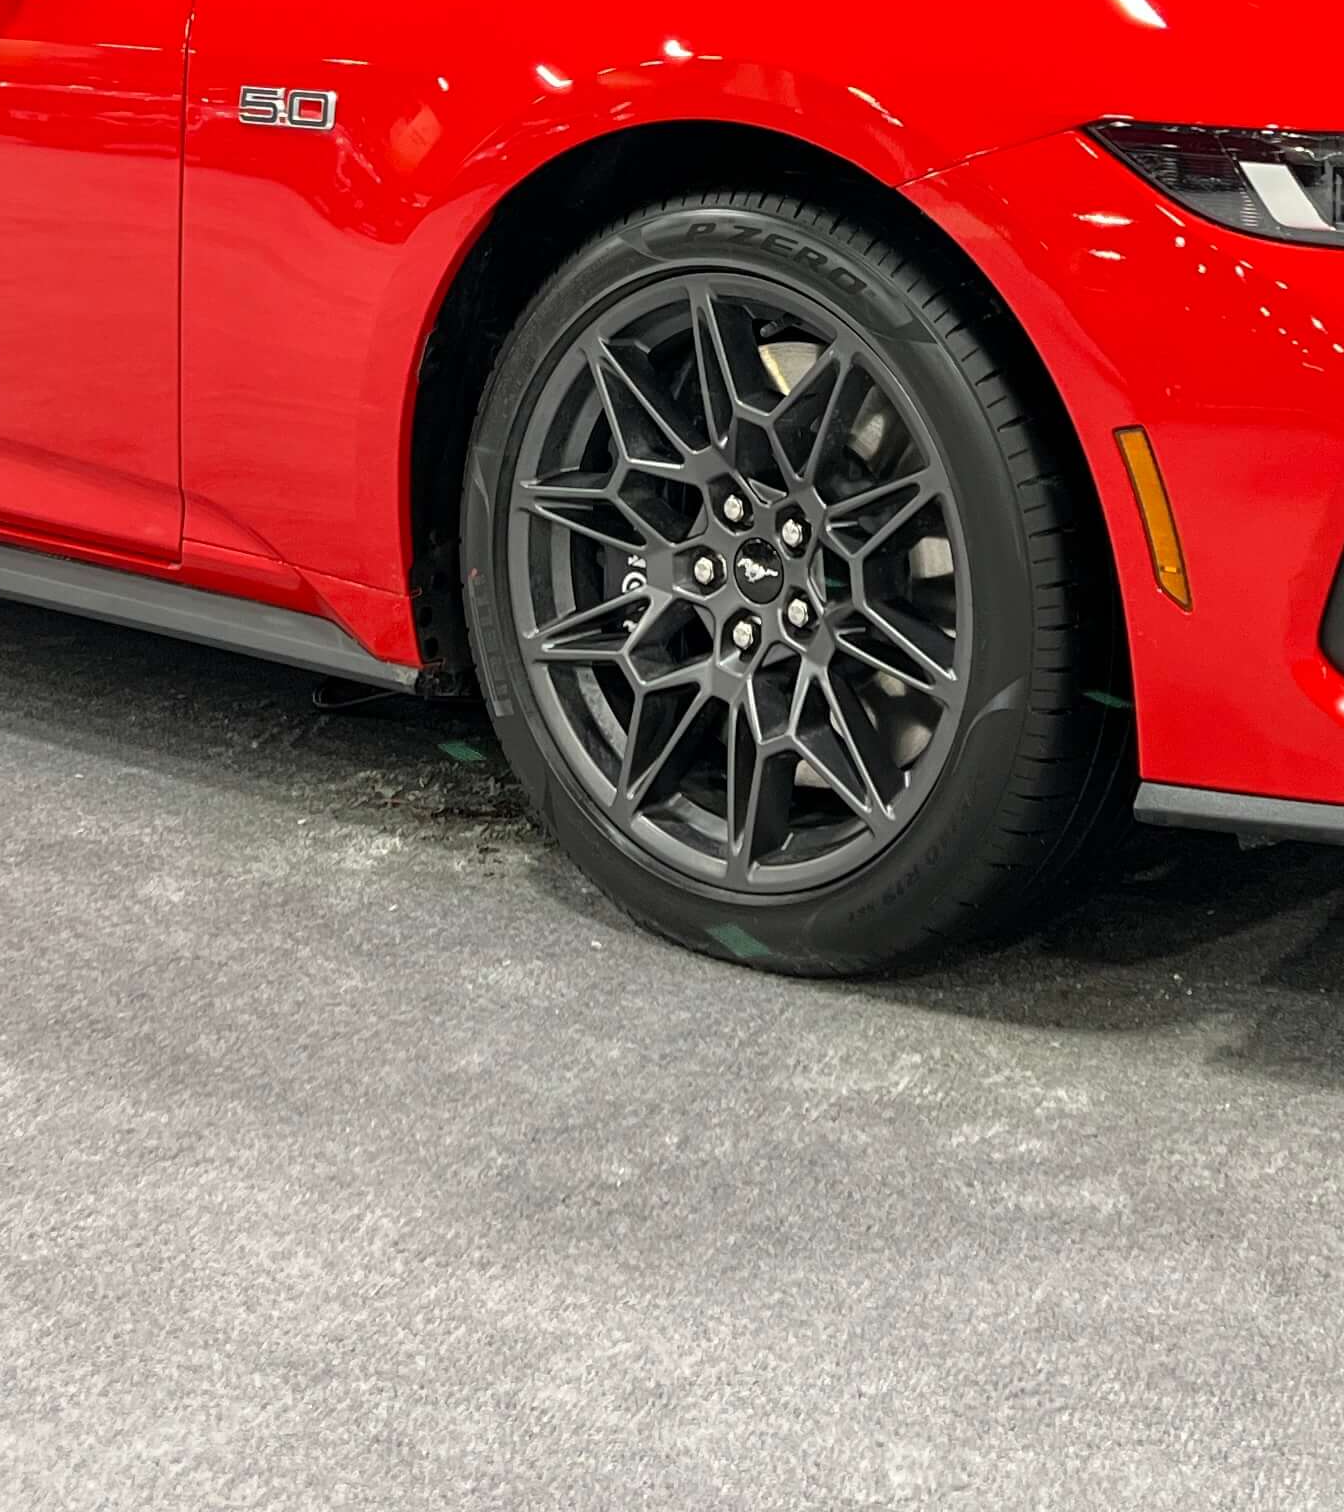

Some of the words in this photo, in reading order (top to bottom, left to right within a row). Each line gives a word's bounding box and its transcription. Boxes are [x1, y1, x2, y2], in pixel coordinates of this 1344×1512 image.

[239, 85, 337, 130] 5.0
[684, 222, 717, 244] P
[726, 224, 868, 296] ZERO
